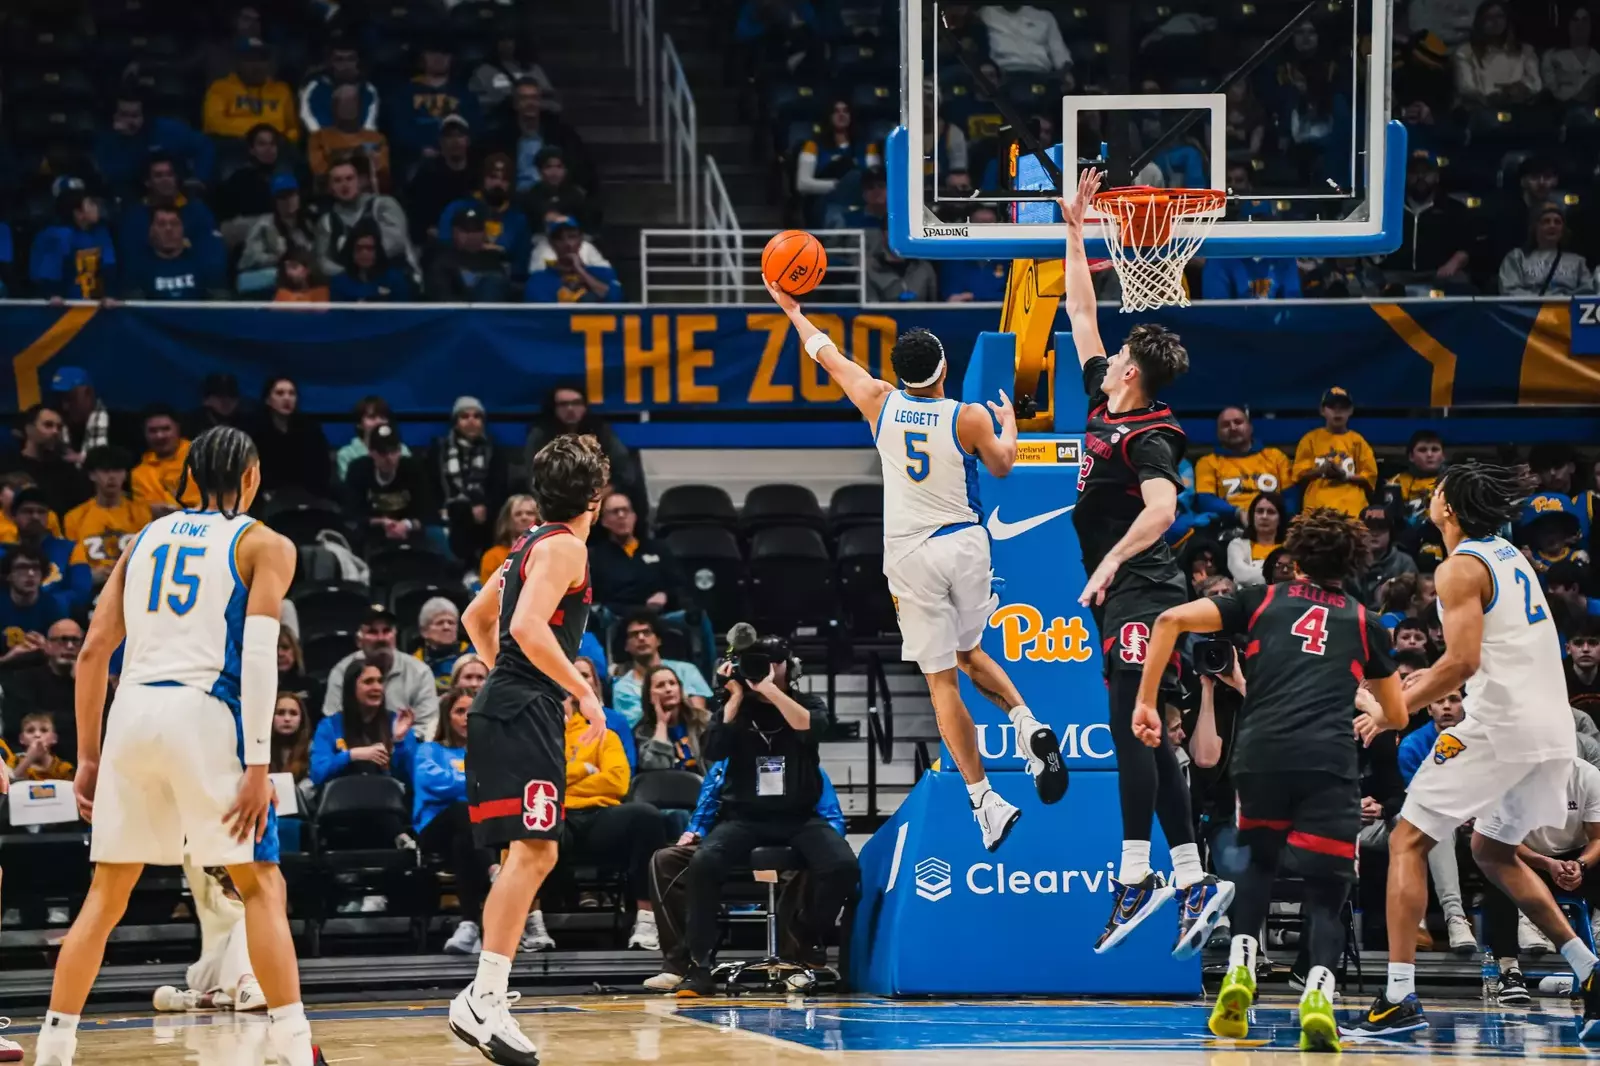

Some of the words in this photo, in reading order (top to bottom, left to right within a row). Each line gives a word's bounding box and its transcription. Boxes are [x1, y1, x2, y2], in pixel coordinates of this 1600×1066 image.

[923, 227, 968, 238] SPALDING
[1579, 303, 1600, 324] Z
[570, 314, 719, 403] THE
[747, 313, 898, 402] ZOO
[895, 410, 939, 426] LEGGETT
[904, 430, 932, 484] 5
[1058, 447, 1077, 458] CAT
[170, 521, 210, 538] LOWE
[147, 543, 208, 617] 15
[1287, 584, 1347, 609] SELLERS
[1514, 567, 1548, 626] 2
[988, 602, 1093, 663] Pitt
[1290, 604, 1329, 656] 4
[975, 723, 1115, 759] UMC
[966, 862, 1177, 894] Clearvi
